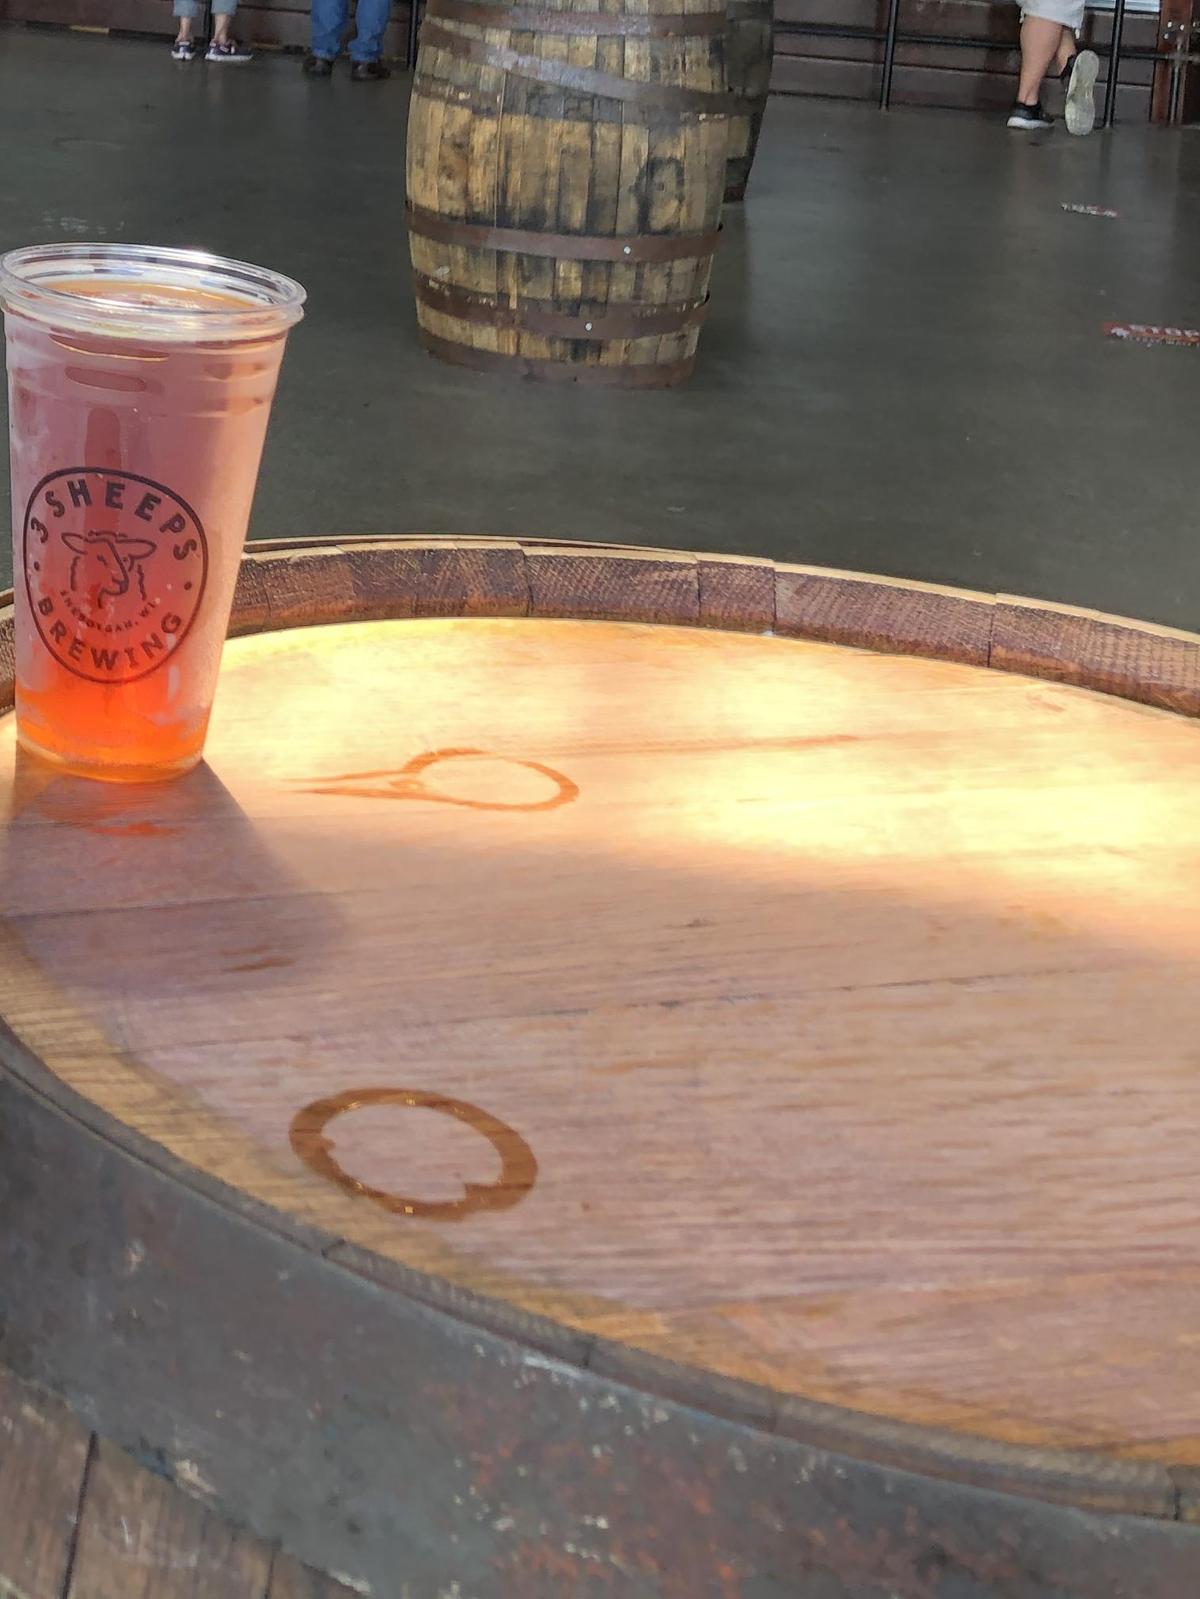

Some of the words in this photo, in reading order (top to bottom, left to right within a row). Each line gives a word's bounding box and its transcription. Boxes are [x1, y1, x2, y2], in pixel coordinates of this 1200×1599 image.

[30, 516, 49, 544] 3
[44, 478, 198, 561] SHEEPS
[37, 596, 183, 671] BREWING
